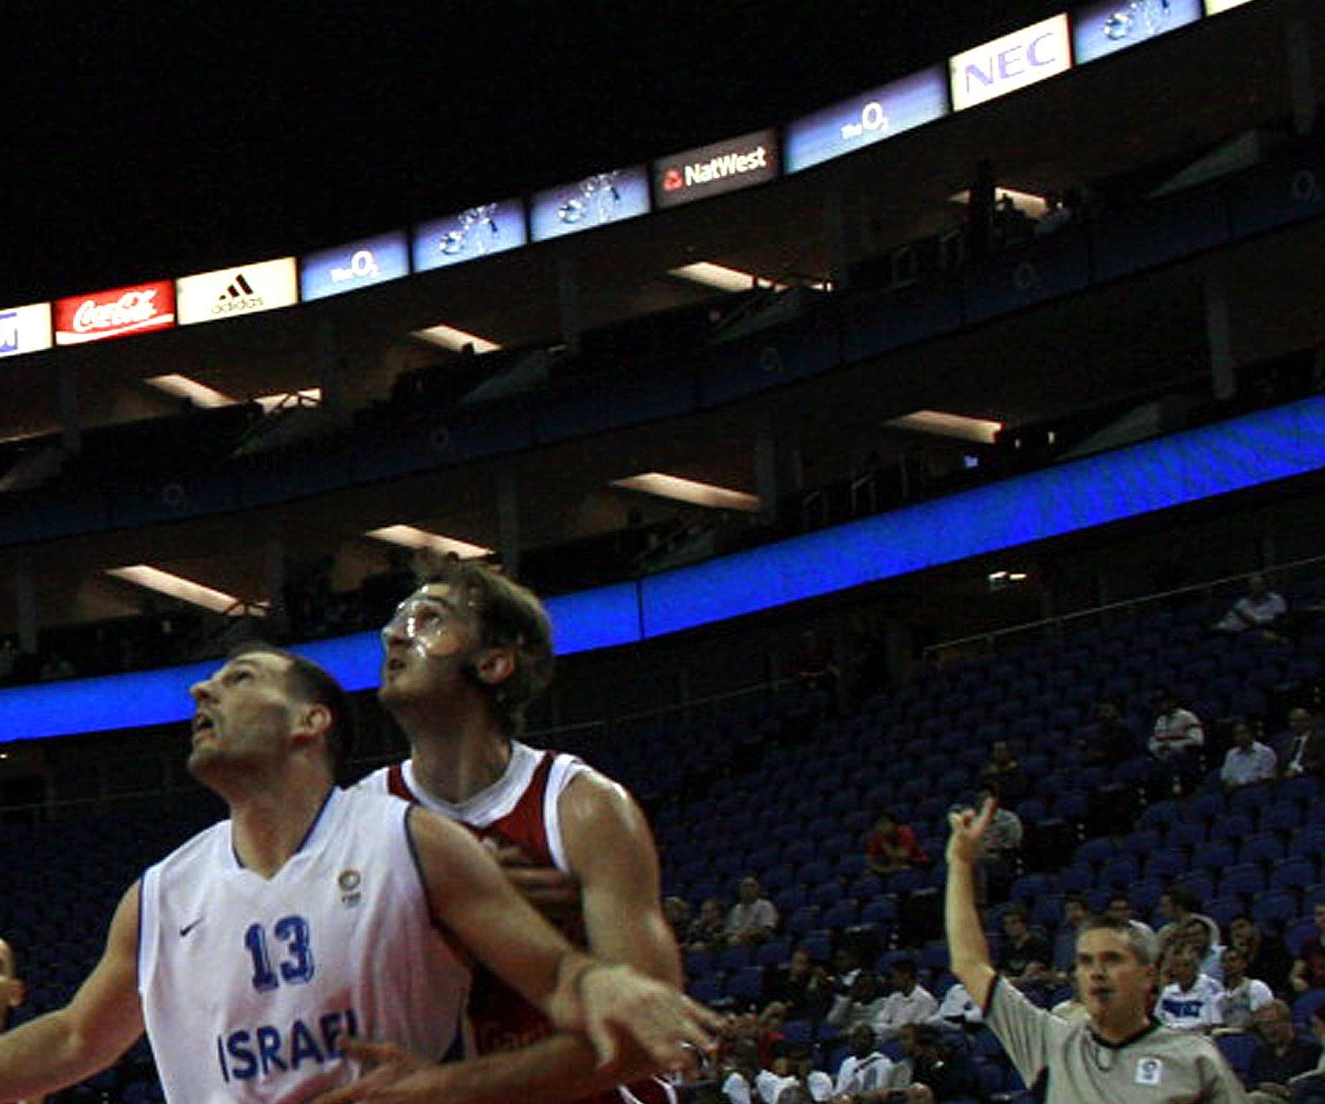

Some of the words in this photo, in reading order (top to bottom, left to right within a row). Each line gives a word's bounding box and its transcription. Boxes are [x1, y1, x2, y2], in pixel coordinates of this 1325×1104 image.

[964, 32, 1055, 94] NEC
[684, 146, 767, 187] NatWest
[211, 296, 264, 316] adidas
[244, 914, 316, 994] 13
